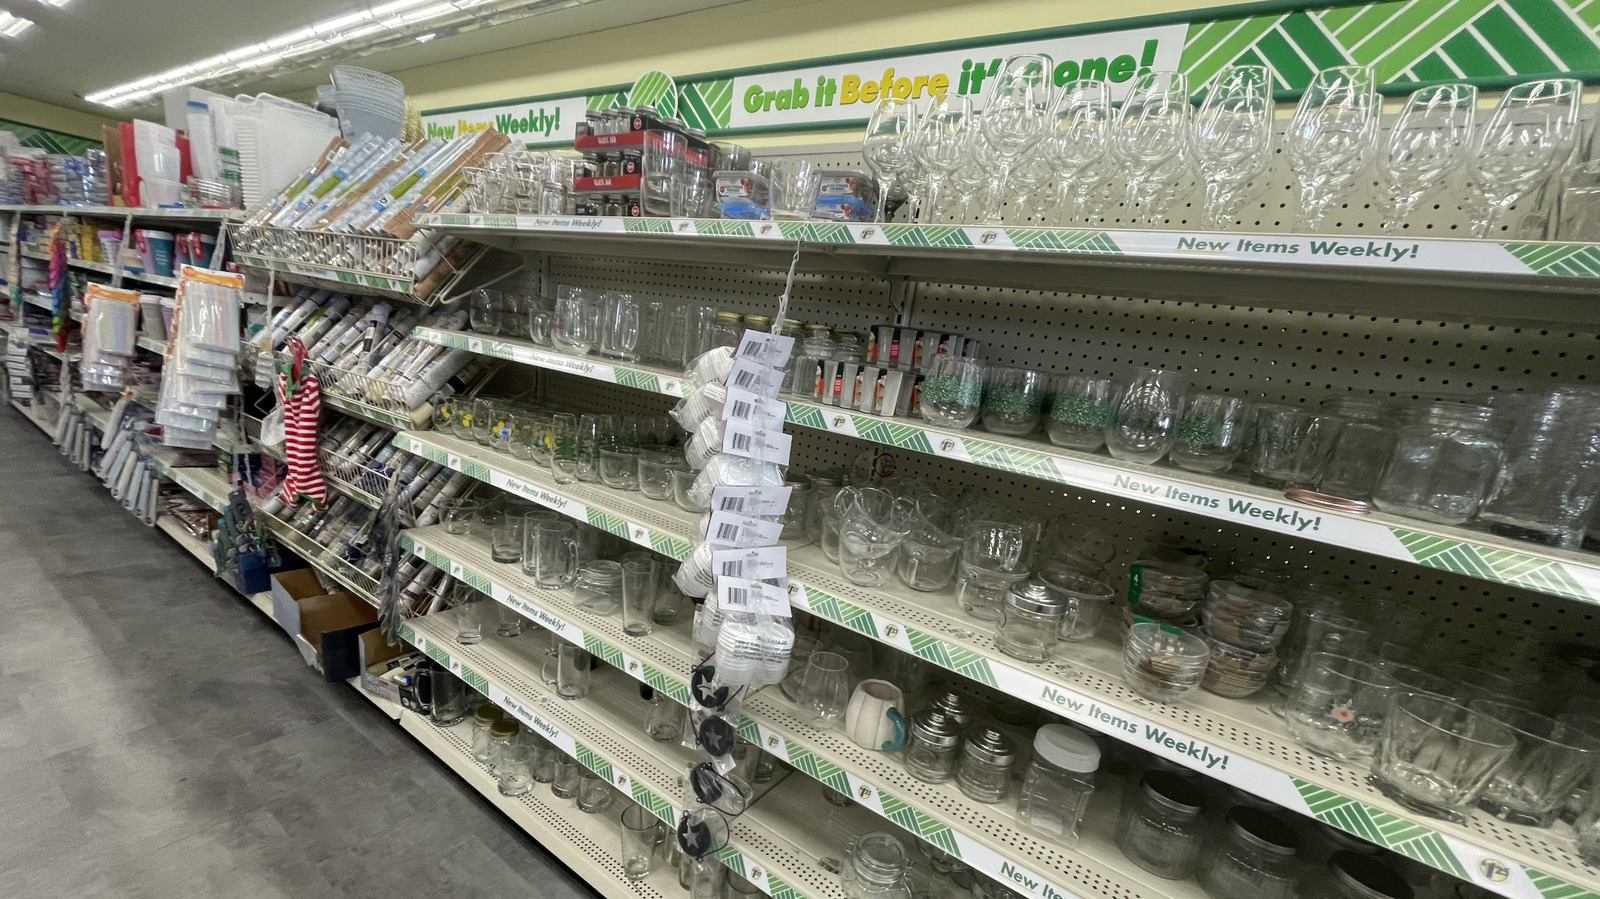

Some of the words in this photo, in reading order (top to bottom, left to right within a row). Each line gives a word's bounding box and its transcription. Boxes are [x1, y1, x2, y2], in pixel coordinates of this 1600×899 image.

[743, 78, 809, 113] Grab
[814, 75, 838, 107] it
[839, 67, 950, 106] Before
[427, 122, 456, 140] New
[495, 106, 561, 138] Weekly!
[534, 218, 551, 226] New
[571, 219, 602, 230] Weekly!
[1176, 236, 1230, 251] New
[1236, 238, 1300, 255] Items
[1309, 241, 1419, 262] Weekly!
[565, 360, 594, 373] Weekly!
[506, 478, 522, 490] New
[522, 484, 540, 497] Items
[540, 491, 568, 508] Weekly!
[1113, 474, 1160, 495] New
[1165, 485, 1220, 509] Items
[1228, 497, 1322, 532] Weekly!
[506, 594, 522, 607] New
[521, 602, 538, 616] Items
[539, 611, 566, 631] Weekly!
[503, 696, 518, 709] New
[517, 705, 534, 721] Items
[533, 716, 559, 738] Weekly!
[1041, 685, 1084, 712] New
[1088, 703, 1138, 734] Items
[1145, 725, 1229, 770] Weekly!
[1000, 861, 1039, 890] New
[1042, 884, 1066, 899] Ite
